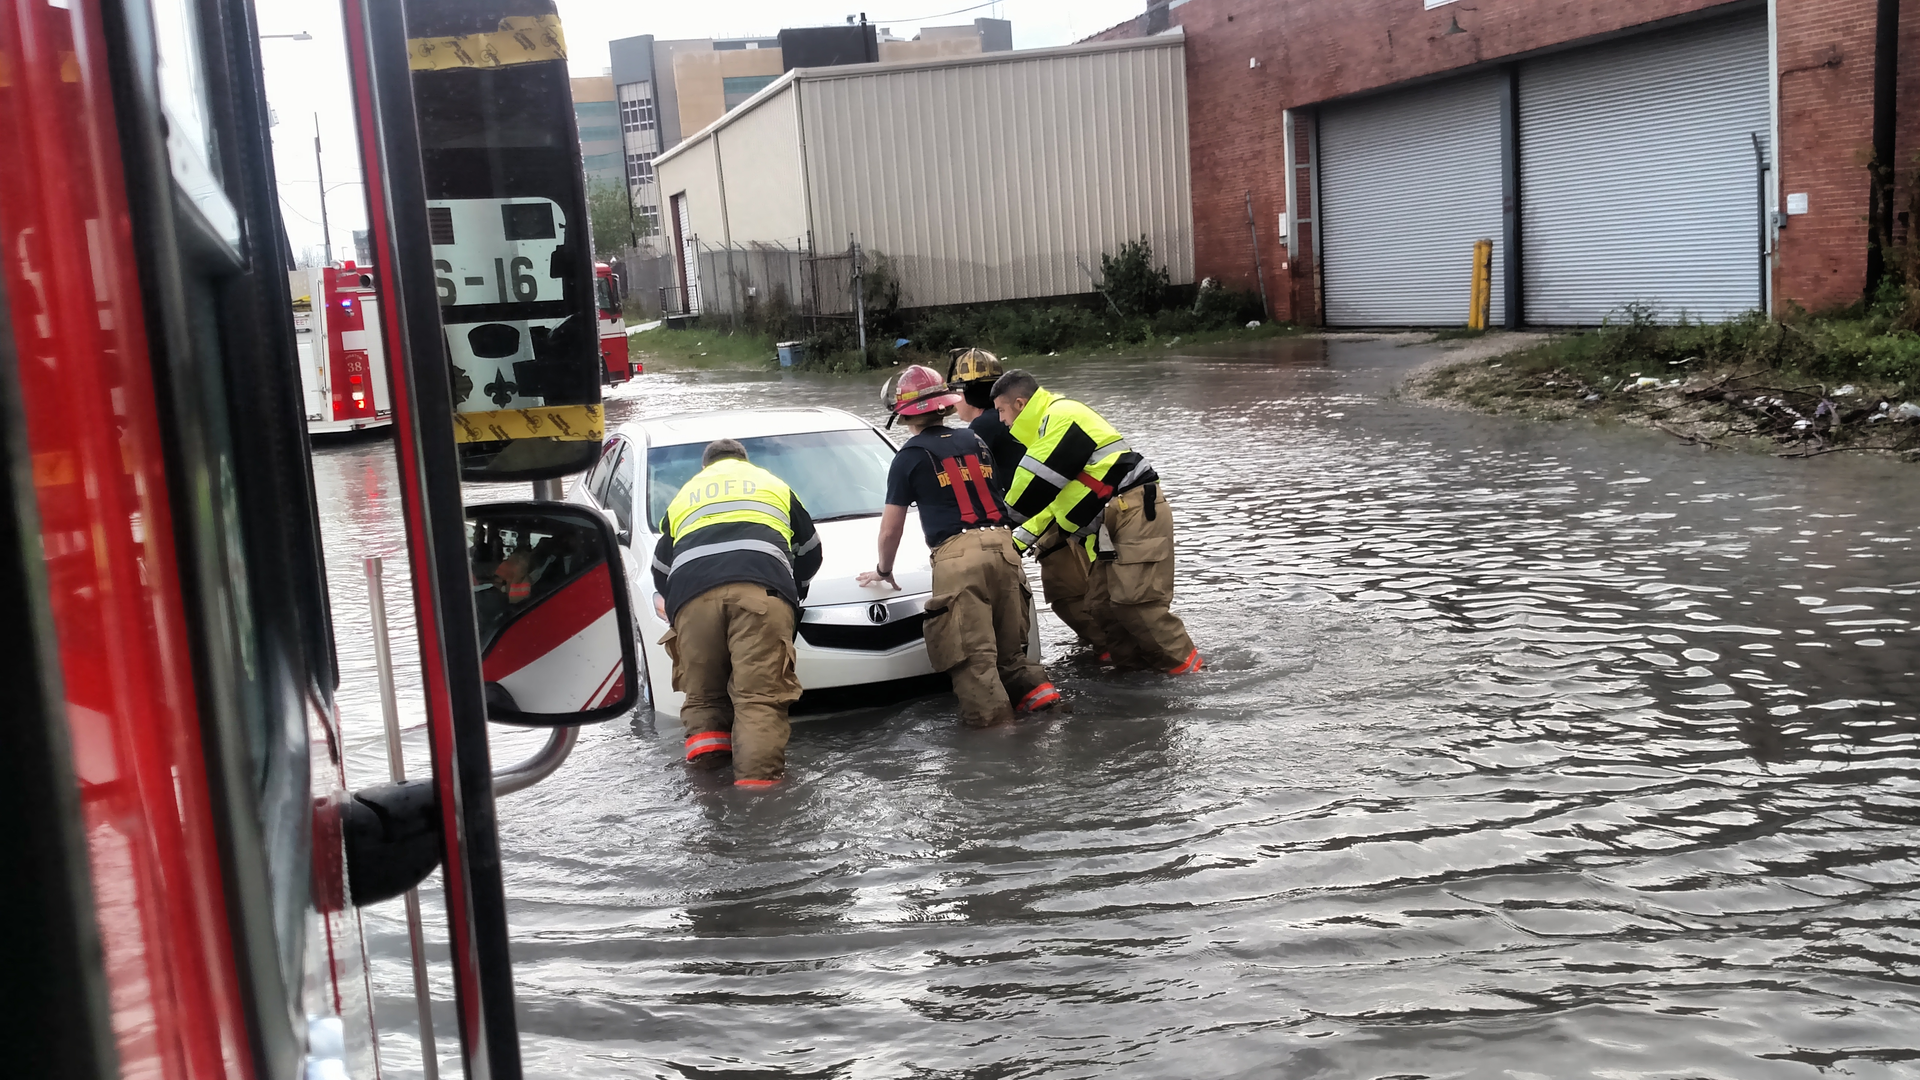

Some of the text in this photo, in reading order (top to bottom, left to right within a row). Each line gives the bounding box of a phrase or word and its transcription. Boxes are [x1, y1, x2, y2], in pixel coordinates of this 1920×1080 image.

[347, 361, 362, 372] 38
[937, 466, 993, 488] DERTENT
[689, 479, 757, 507] NOFD
